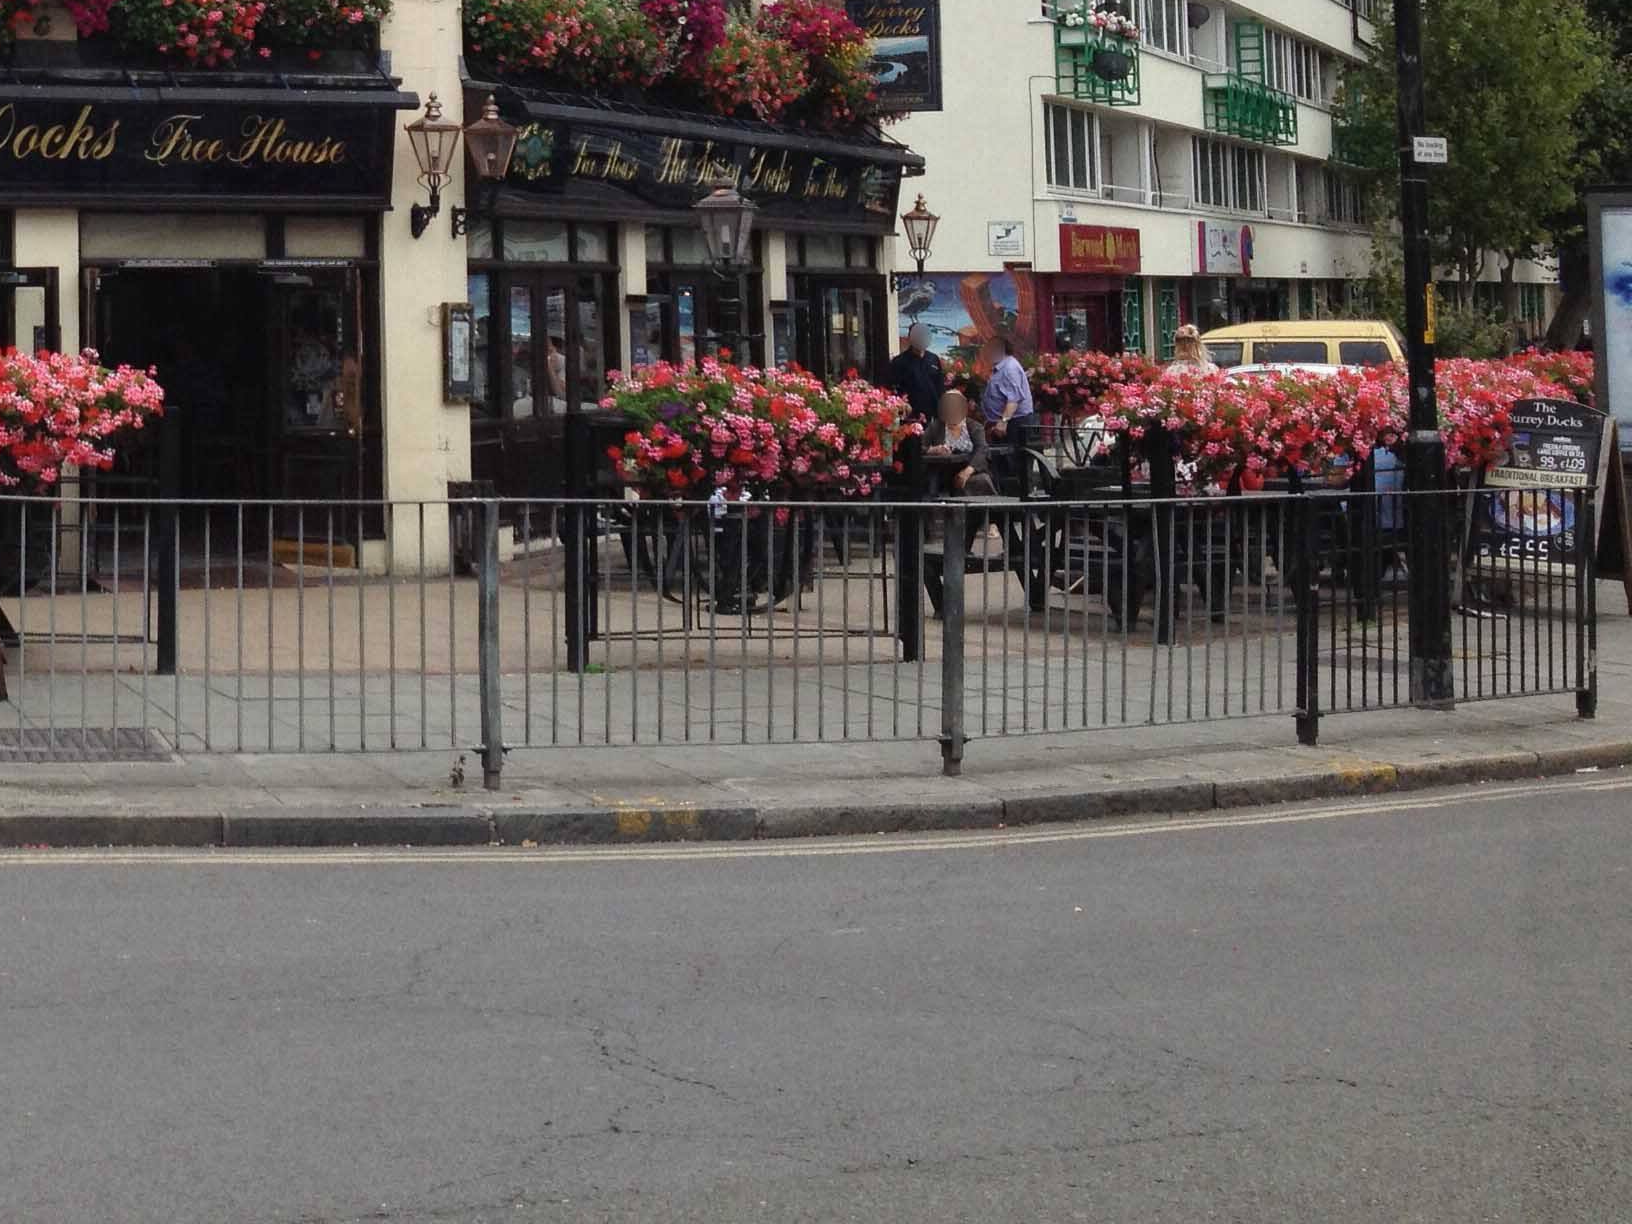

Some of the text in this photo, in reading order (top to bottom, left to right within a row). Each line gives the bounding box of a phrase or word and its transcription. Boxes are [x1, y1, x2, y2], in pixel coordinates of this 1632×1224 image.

[865, 6, 926, 23] Surrey
[870, 19, 921, 36] Docks
[144, 113, 345, 167] Free House
[1533, 402, 1557, 414] The
[1507, 413, 1583, 429] Surrey Docks
[1490, 470, 1538, 482] TRADITIONAL
[1539, 473, 1585, 485] BREAKFAST
